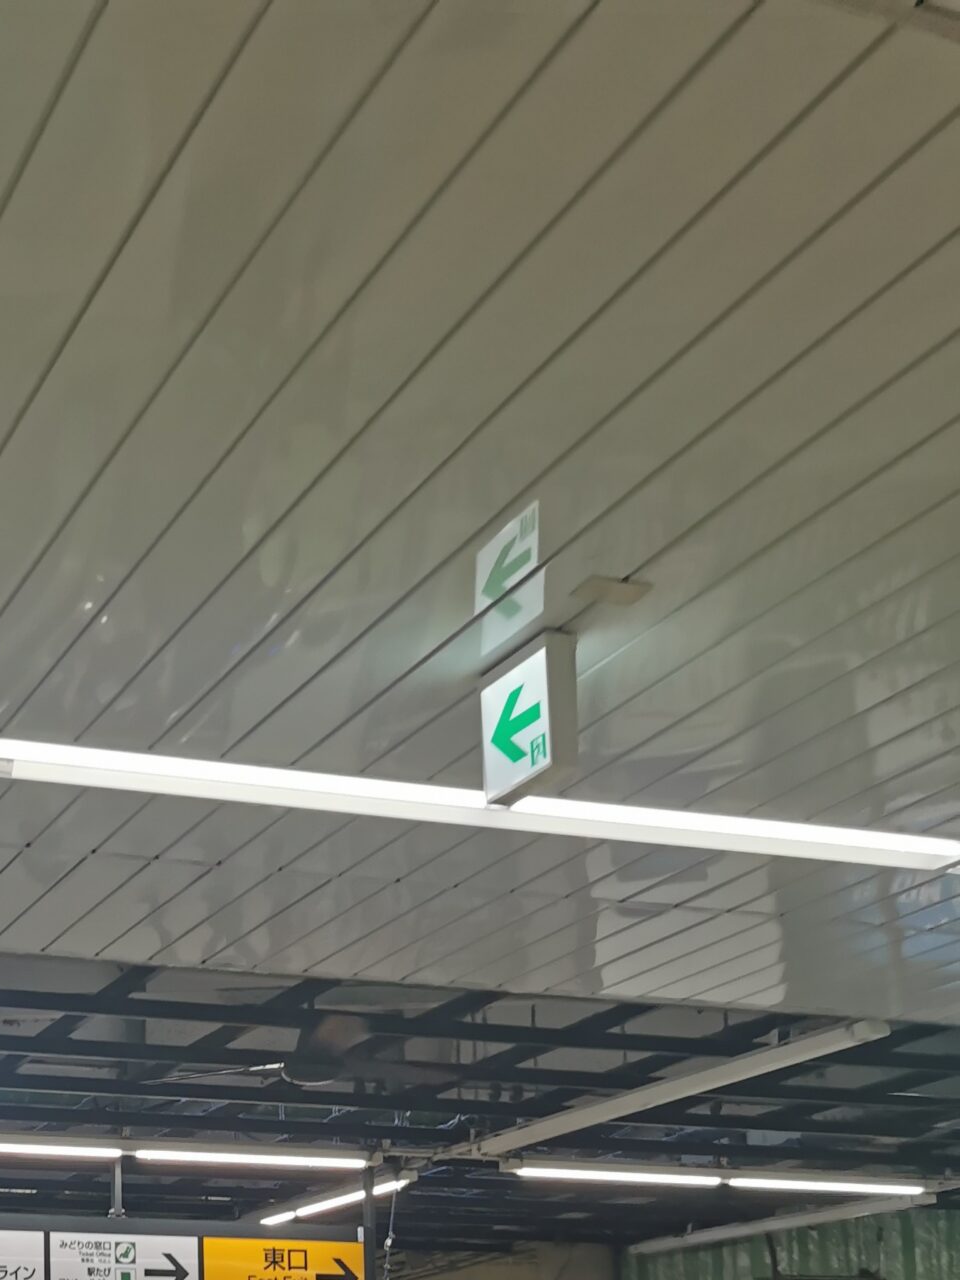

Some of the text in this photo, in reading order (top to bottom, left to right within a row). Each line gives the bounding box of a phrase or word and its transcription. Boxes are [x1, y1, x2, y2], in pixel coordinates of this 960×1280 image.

[59, 1239, 112, 1251] みどりの窓口
[263, 1248, 308, 1271] 東口
[87, 1266, 112, 1278] 駅たび
